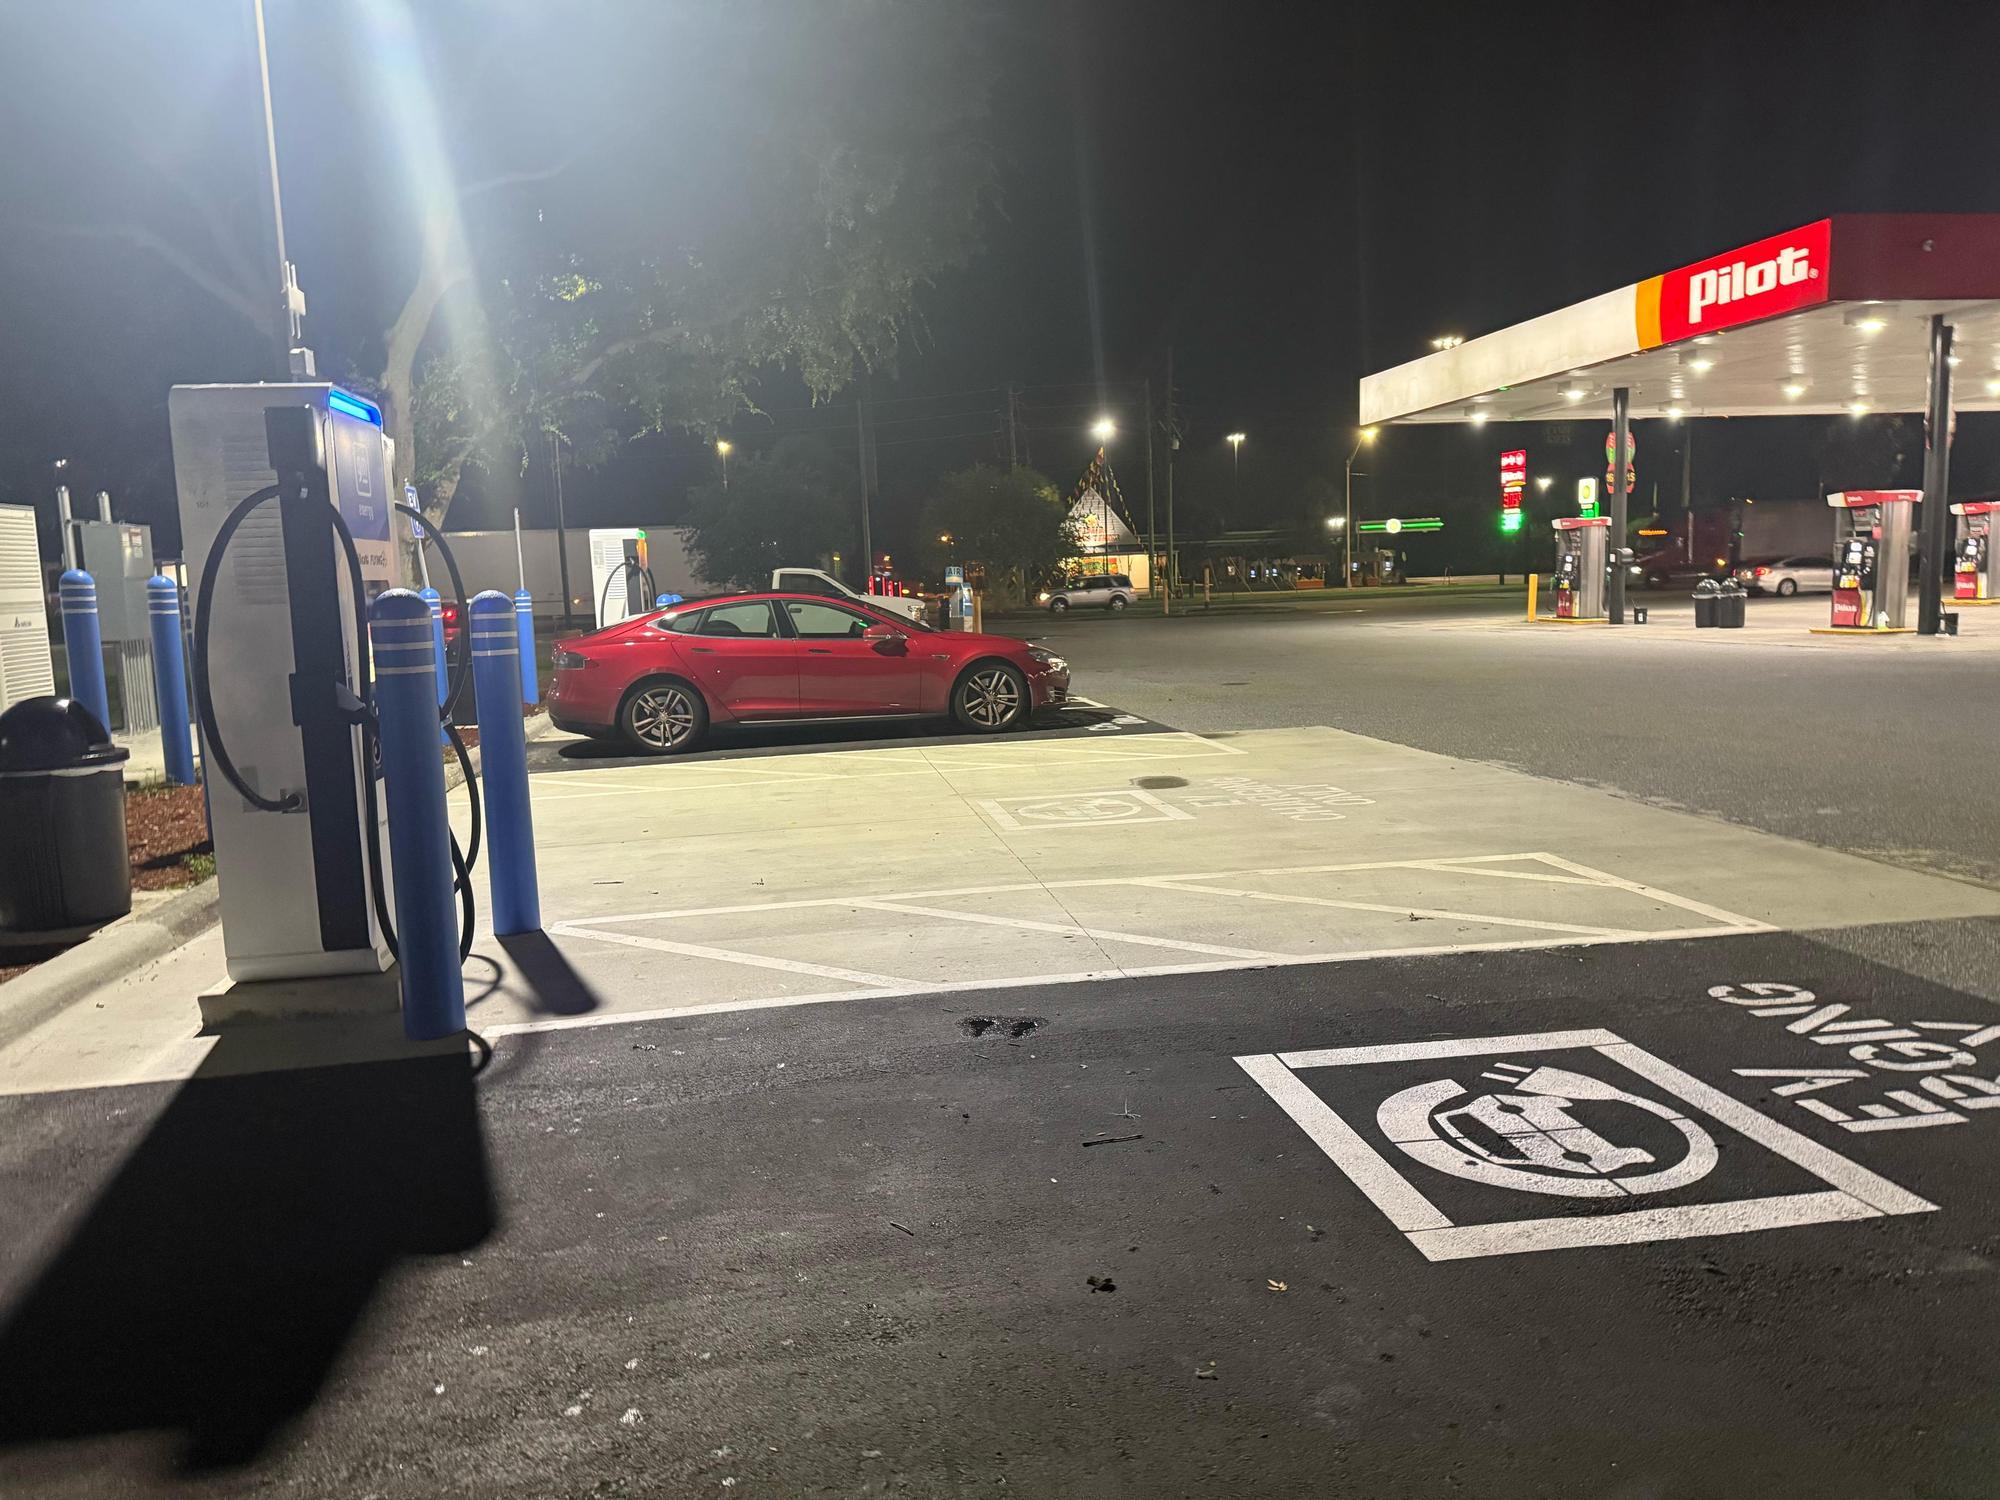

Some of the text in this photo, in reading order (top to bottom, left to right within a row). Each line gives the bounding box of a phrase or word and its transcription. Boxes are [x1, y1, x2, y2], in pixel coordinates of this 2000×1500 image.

[1689, 247, 1810, 324] Pilot
[948, 568, 961, 576] AIR
[1707, 982, 2000, 1109] RGING
[1731, 1068, 1970, 1133] EV
